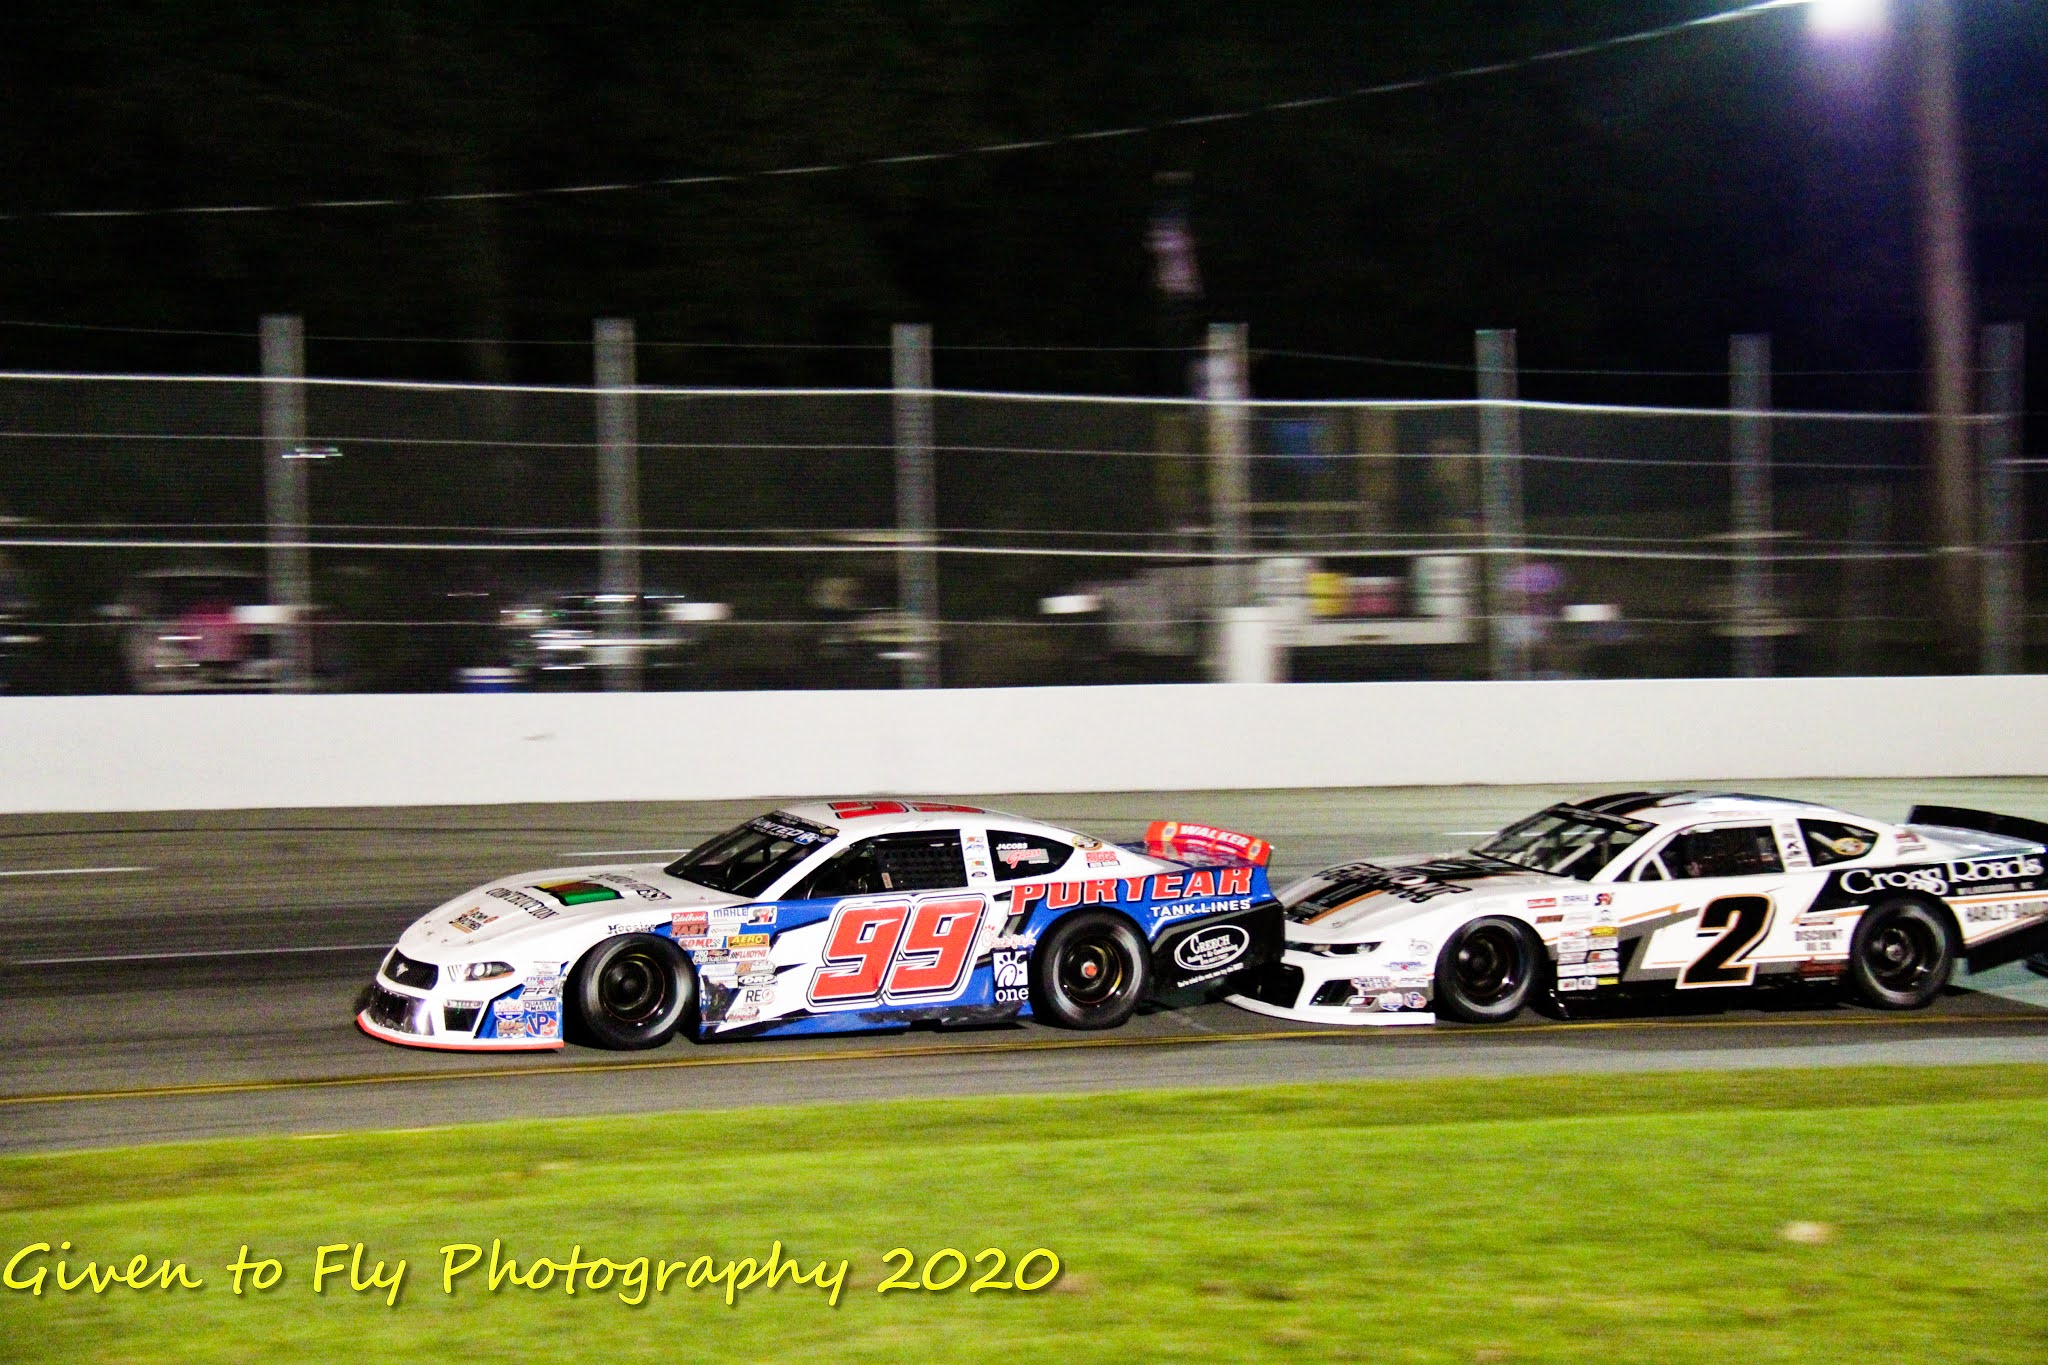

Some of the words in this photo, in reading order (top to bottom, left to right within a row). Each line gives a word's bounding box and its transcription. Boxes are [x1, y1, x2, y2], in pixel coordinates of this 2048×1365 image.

[1180, 825, 1250, 848] WALKER
[1006, 849, 1041, 869] Glass
[1085, 851, 1117, 862] RIGGS
[1840, 868, 1948, 896] Cross
[1947, 855, 2044, 883] Roads
[1008, 866, 1253, 916] PURYEAR
[672, 912, 707, 923] Edelbrock
[713, 908, 748, 918] MAHLE
[1150, 904, 1195, 917] TANK
[1201, 900, 1251, 914] LINES
[732, 935, 763, 944] AERO
[1190, 934, 1231, 955] CREECH
[1676, 892, 1777, 990] 2
[806, 893, 988, 1008] 99
[995, 988, 1029, 1002] one
[527, 1013, 549, 1034] VP
